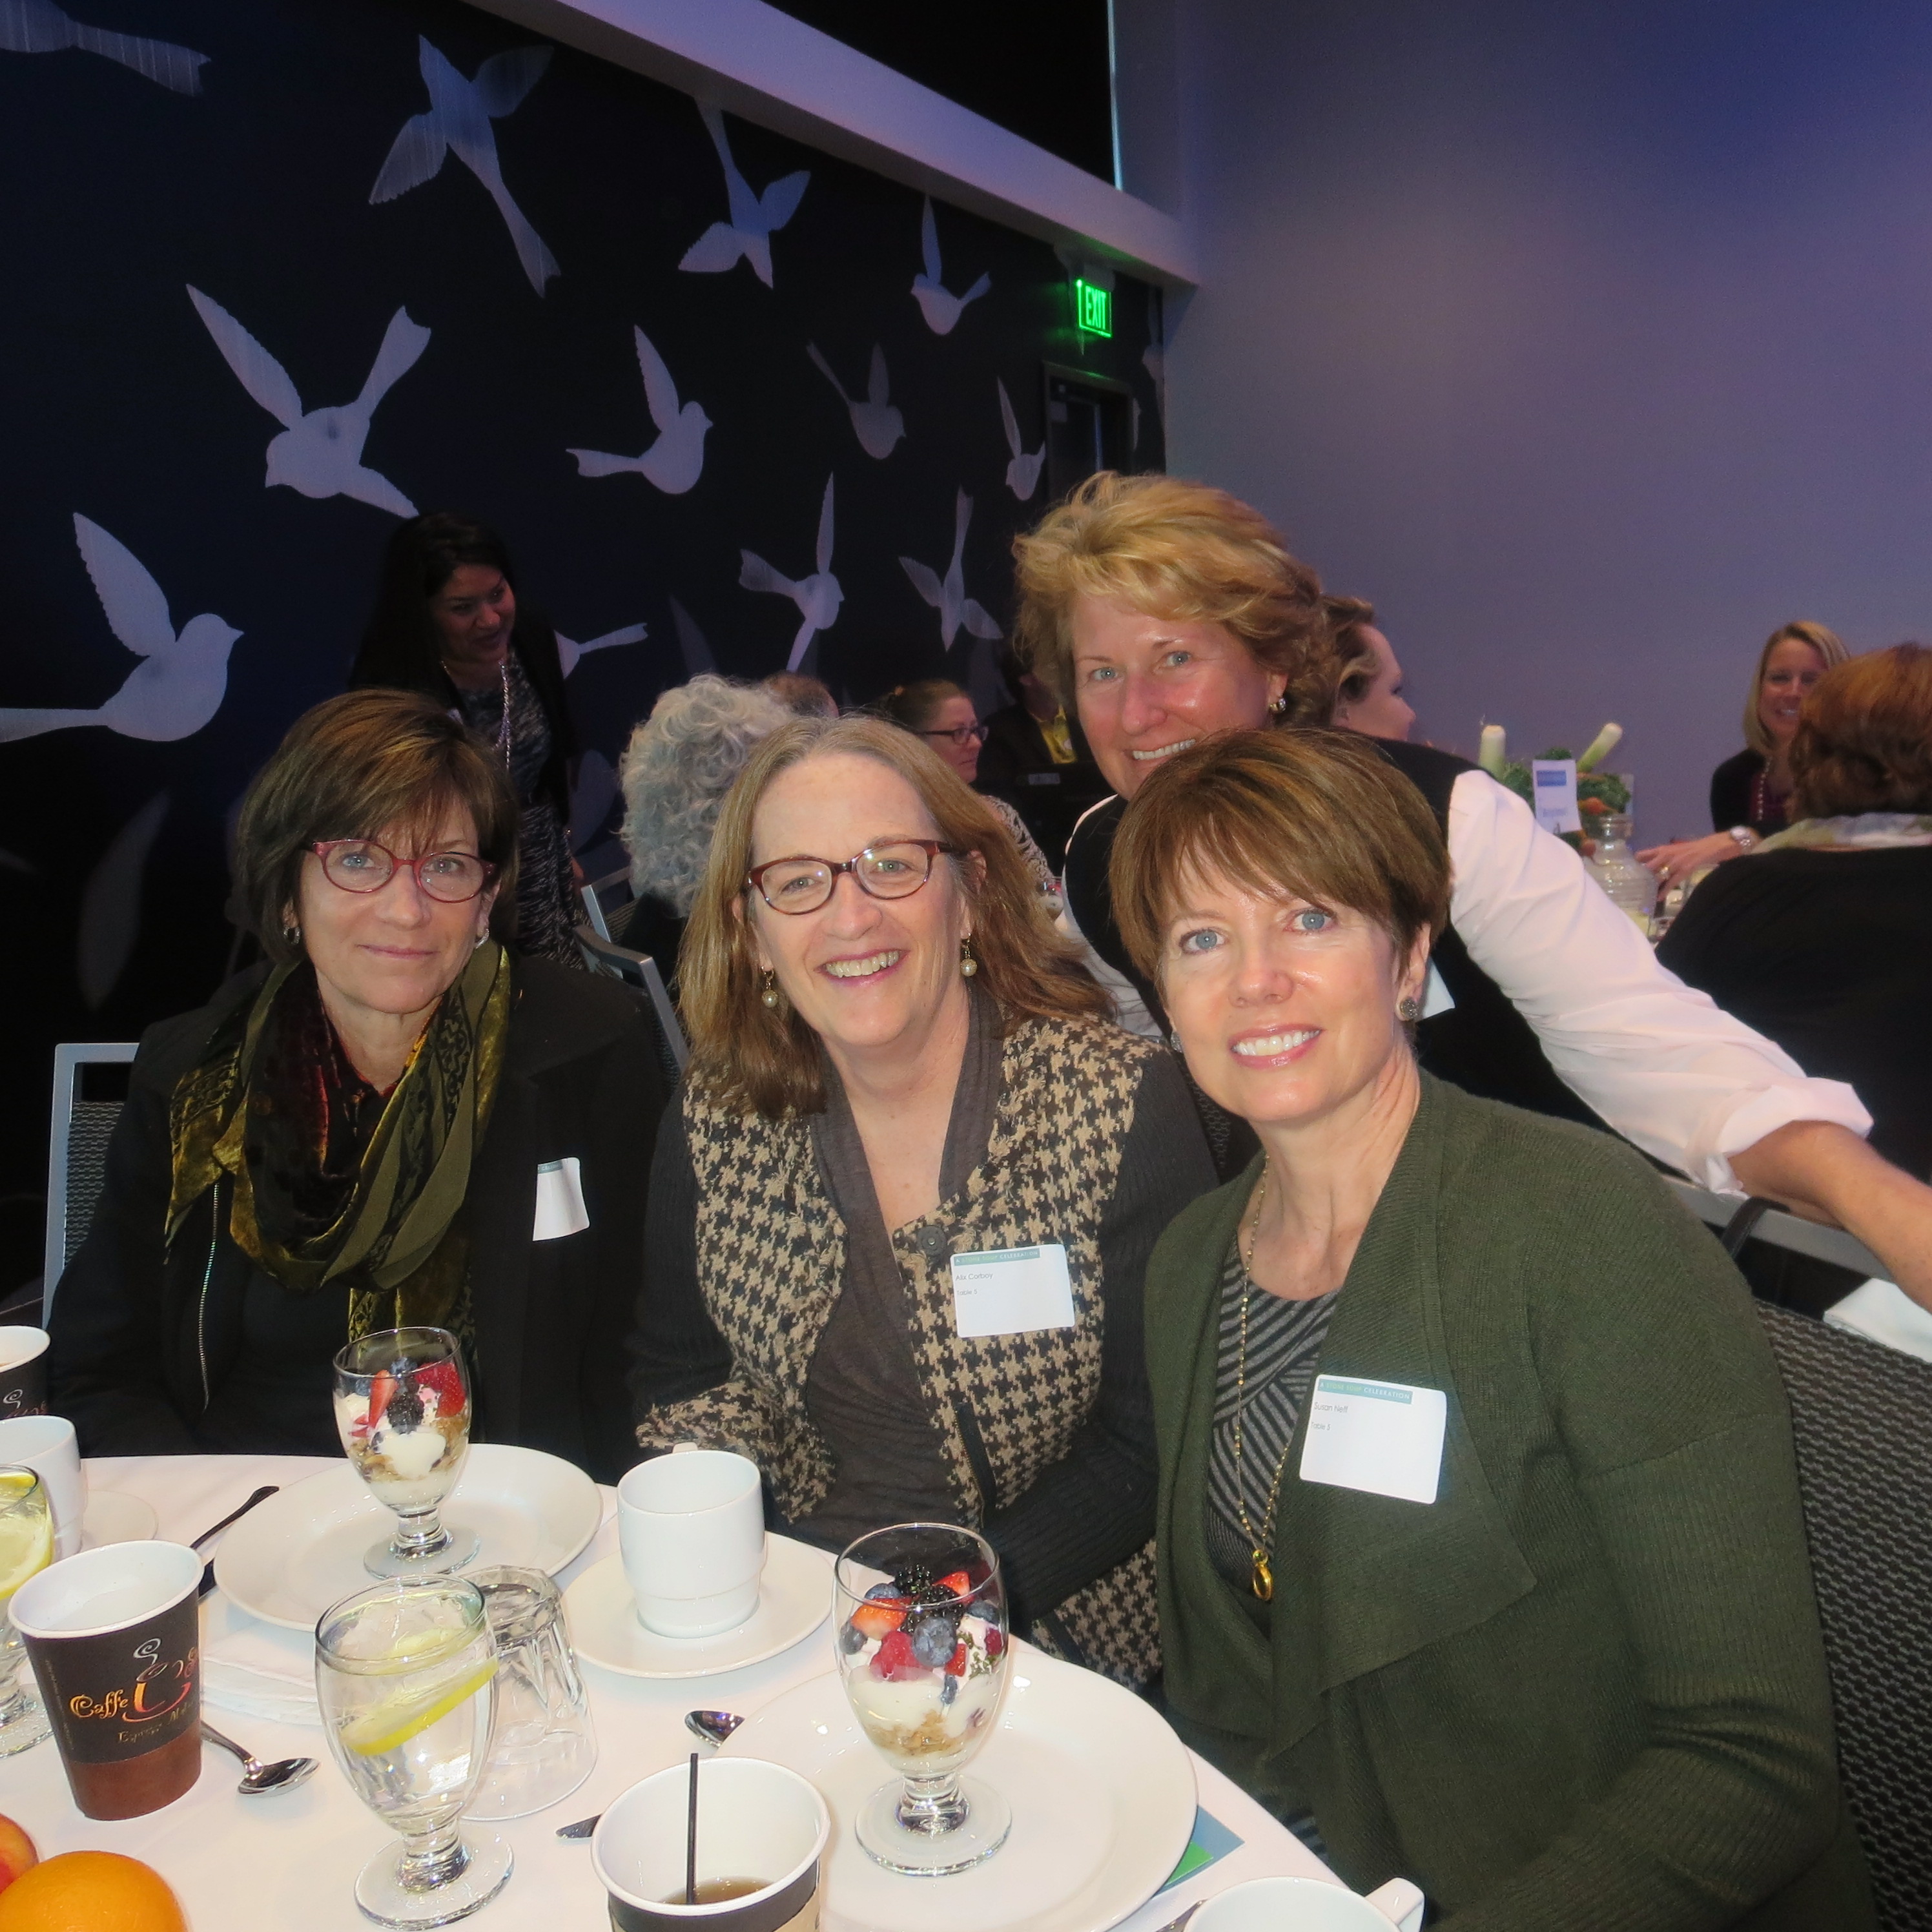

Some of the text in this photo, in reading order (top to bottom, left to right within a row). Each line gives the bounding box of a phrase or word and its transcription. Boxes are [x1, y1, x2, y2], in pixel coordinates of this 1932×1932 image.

[1085, 285, 1106, 330] EXIT
[1364, 1387, 1410, 1399] CELEBRATION
[1314, 1401, 1349, 1413] Susan Neff
[70, 1689, 129, 1719] Caffe
